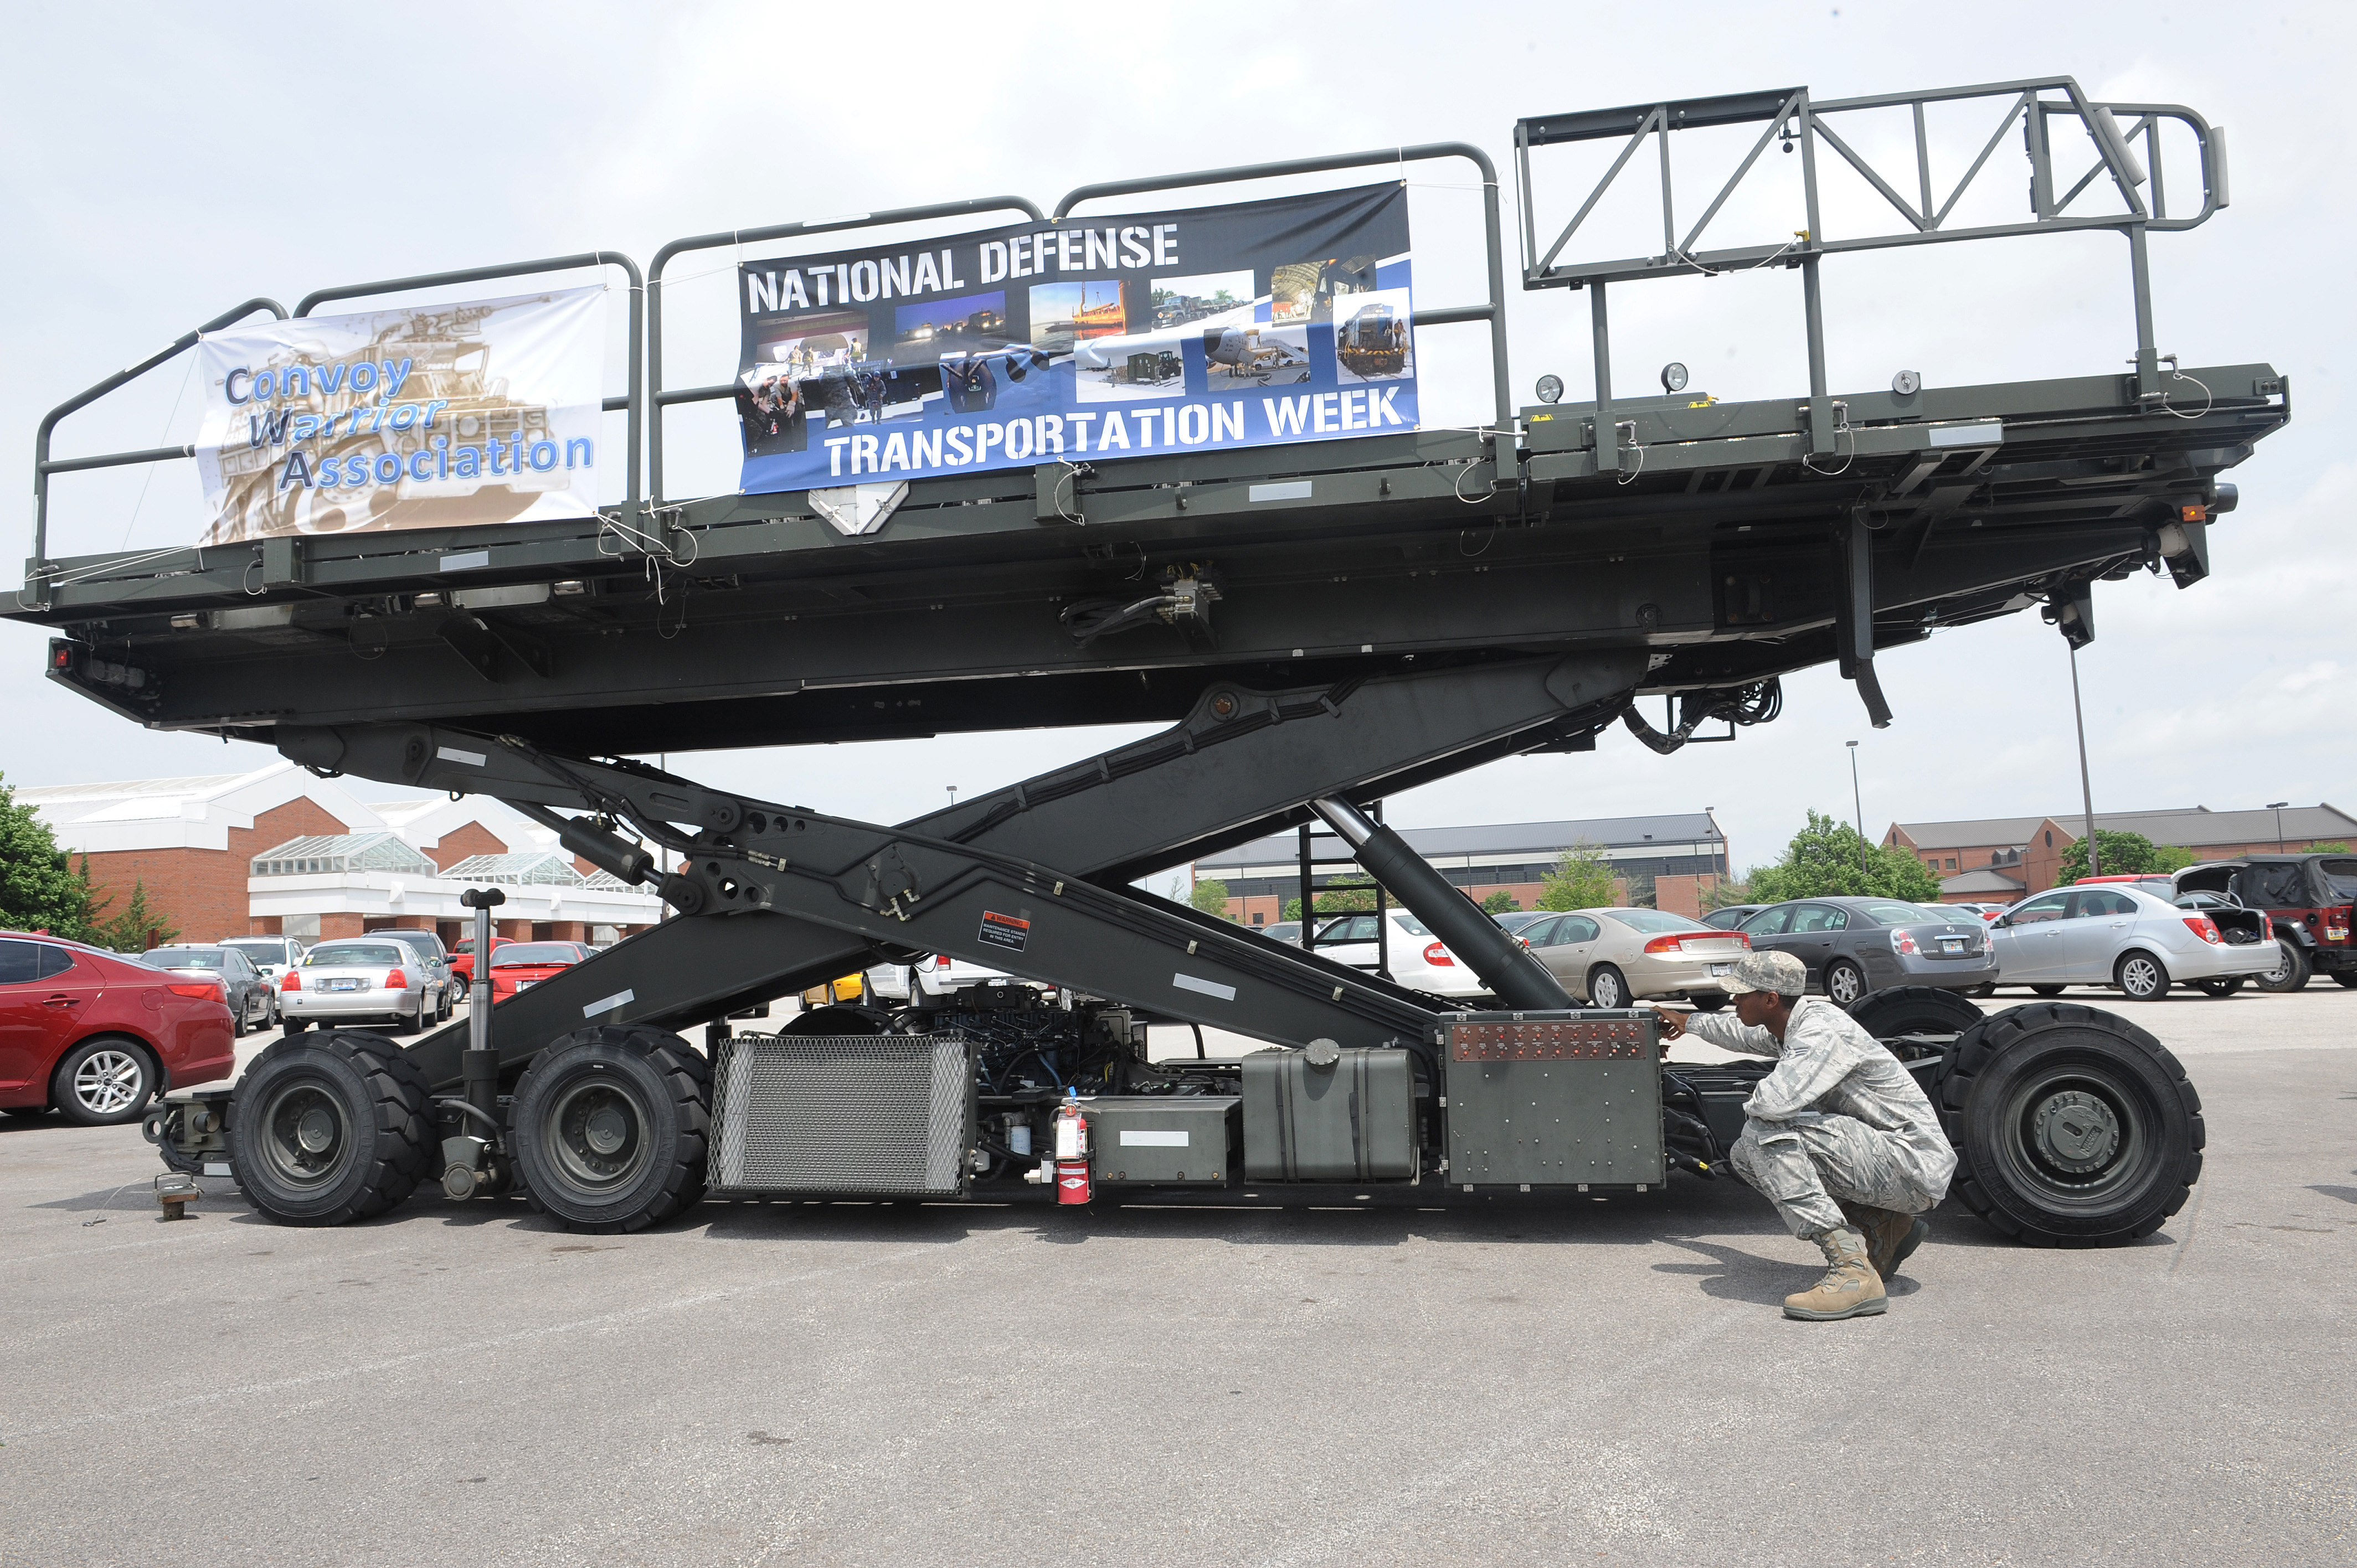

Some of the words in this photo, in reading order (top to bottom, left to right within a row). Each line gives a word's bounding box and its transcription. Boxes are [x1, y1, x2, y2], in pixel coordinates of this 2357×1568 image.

[747, 249, 964, 313] NATIONAL
[980, 223, 1179, 284] DEFENSE
[225, 358, 412, 406] Convoy
[249, 397, 447, 448] Warrior
[824, 400, 1244, 477] TRANSPORTATION
[1263, 386, 1403, 437] WEEK
[278, 431, 593, 491] Association
[983, 924, 1010, 933] MAINTENANCE
[997, 916, 1023, 926] WARNING
